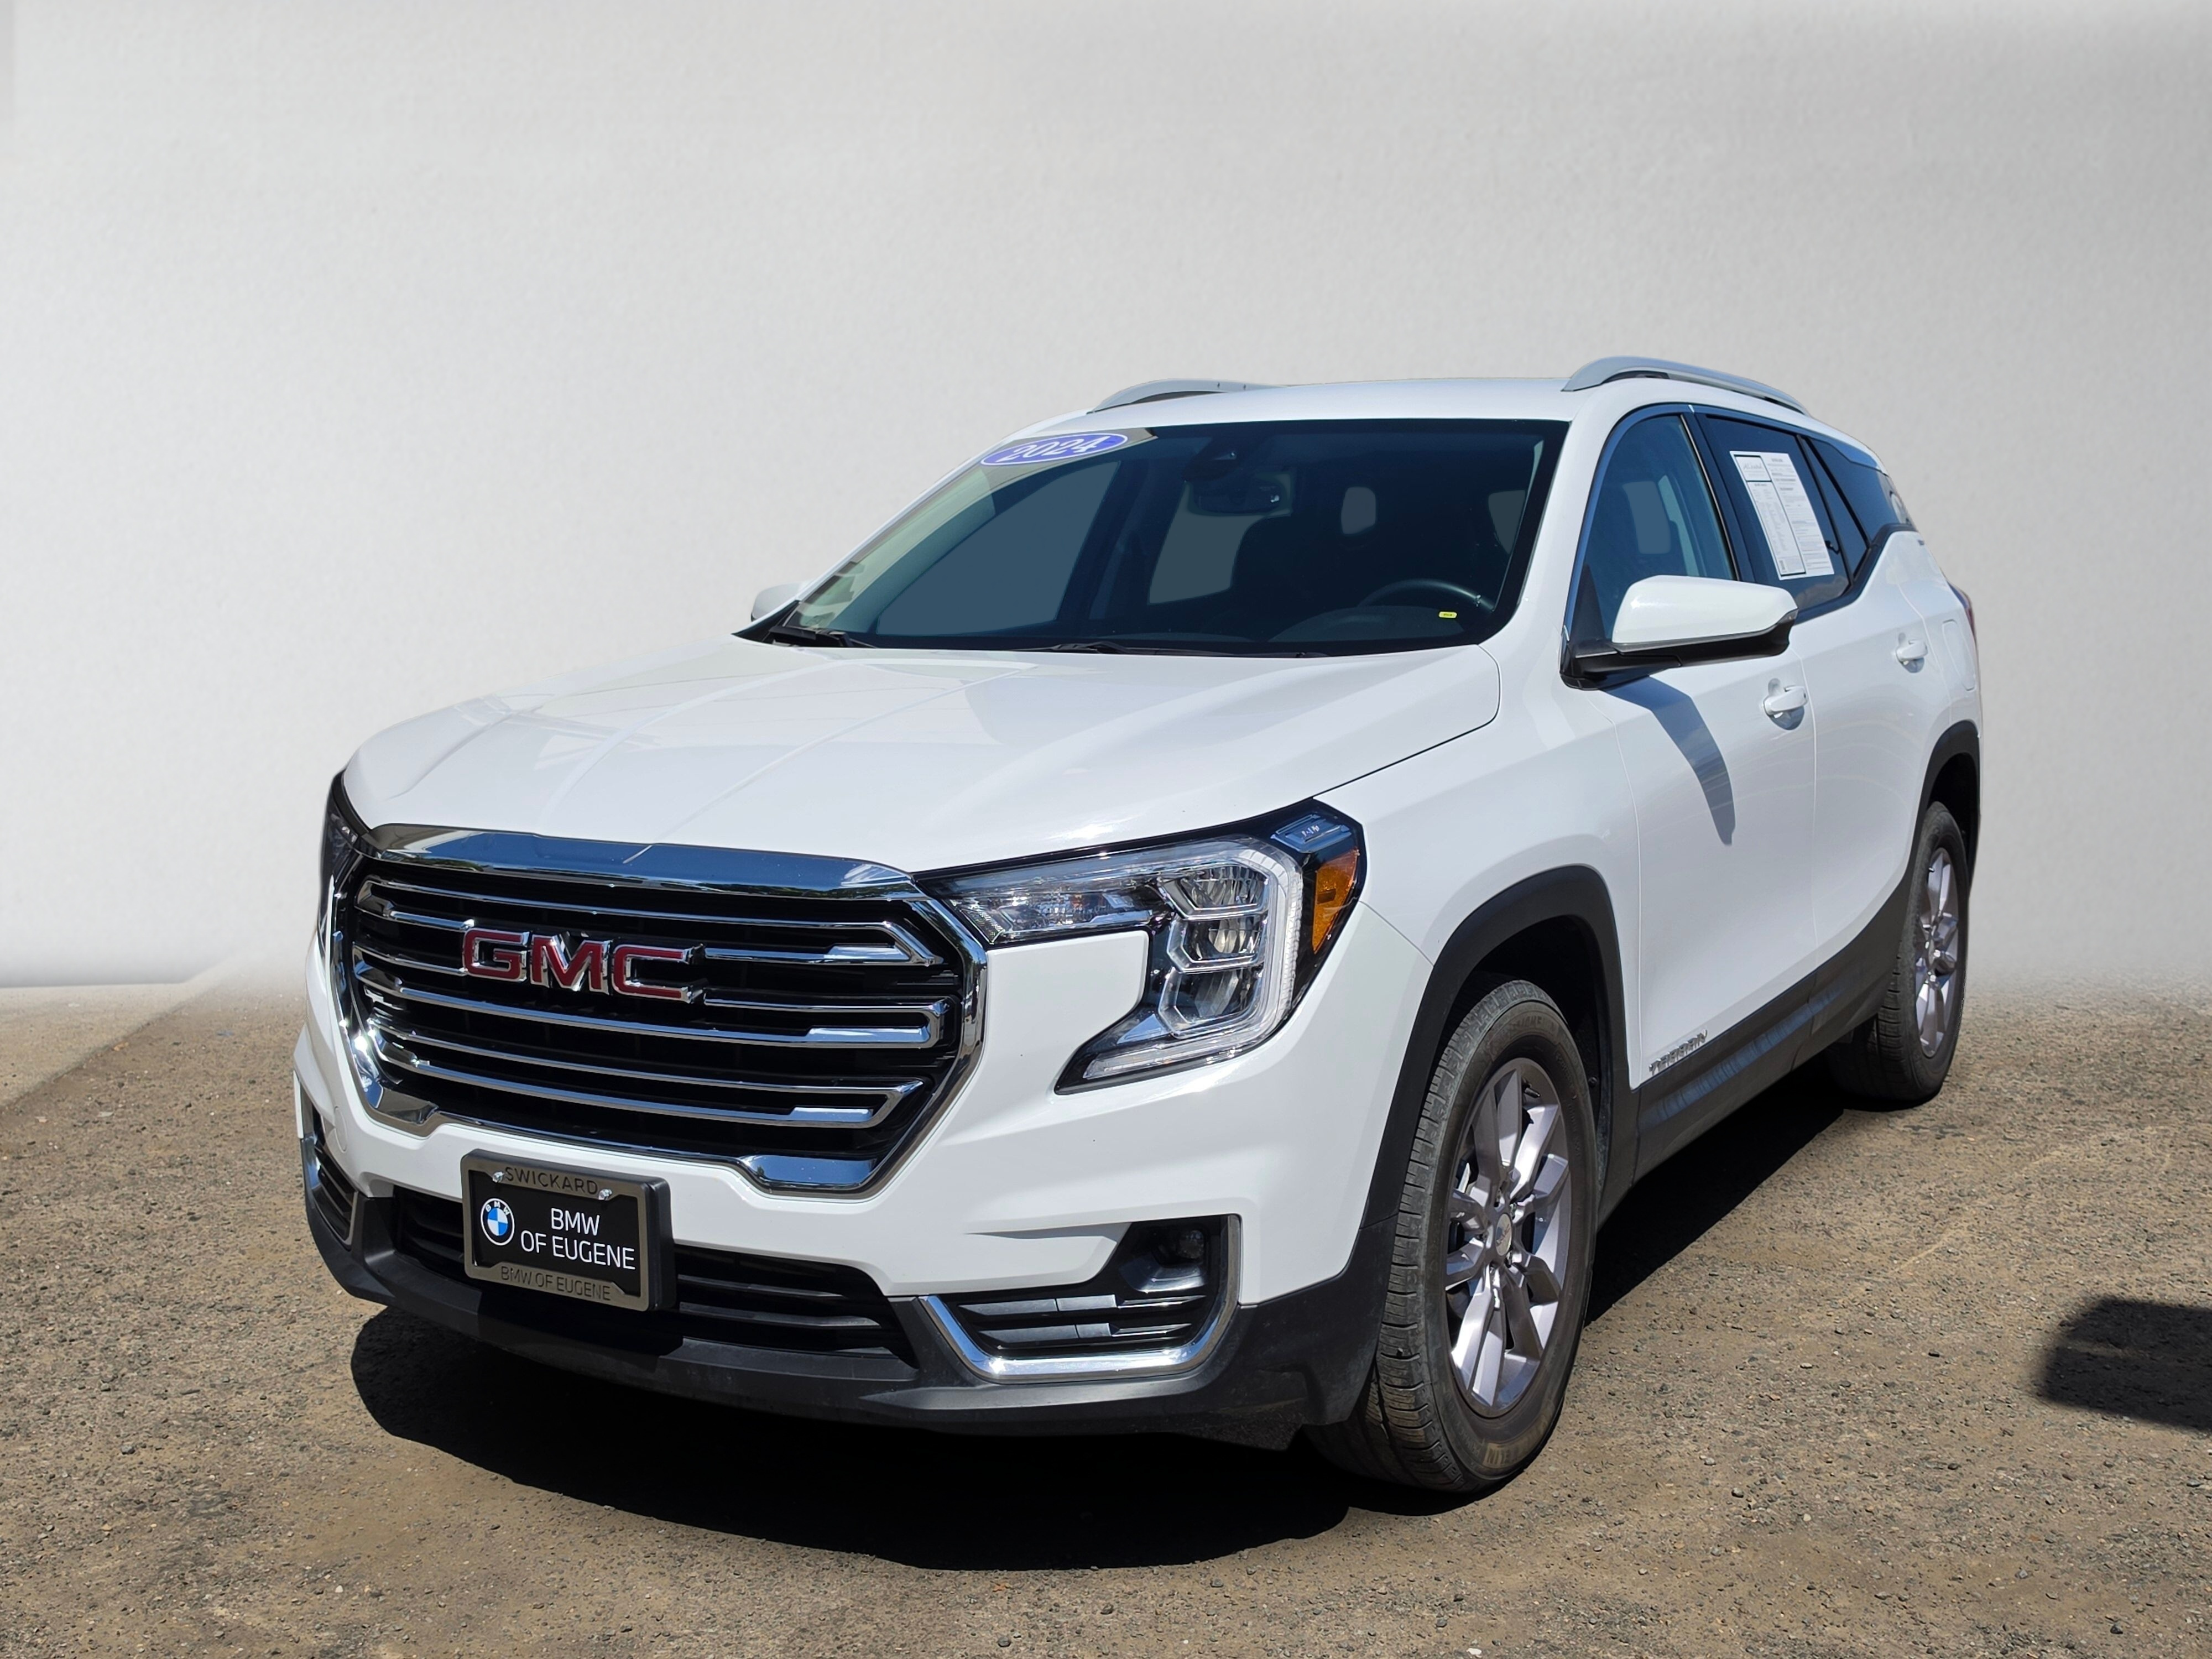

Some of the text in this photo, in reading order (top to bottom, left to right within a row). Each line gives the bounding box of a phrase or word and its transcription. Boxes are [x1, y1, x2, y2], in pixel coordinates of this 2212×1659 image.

[996, 436, 1110, 462] 2024
[462, 927, 695, 1004] GMC
[504, 1166, 598, 1195] SWICKARD
[486, 1201, 510, 1215] BMW
[551, 1208, 600, 1236] BMW
[520, 1230, 635, 1270] OF EUGENE
[500, 1266, 611, 1301] BMW OF EUGENE
